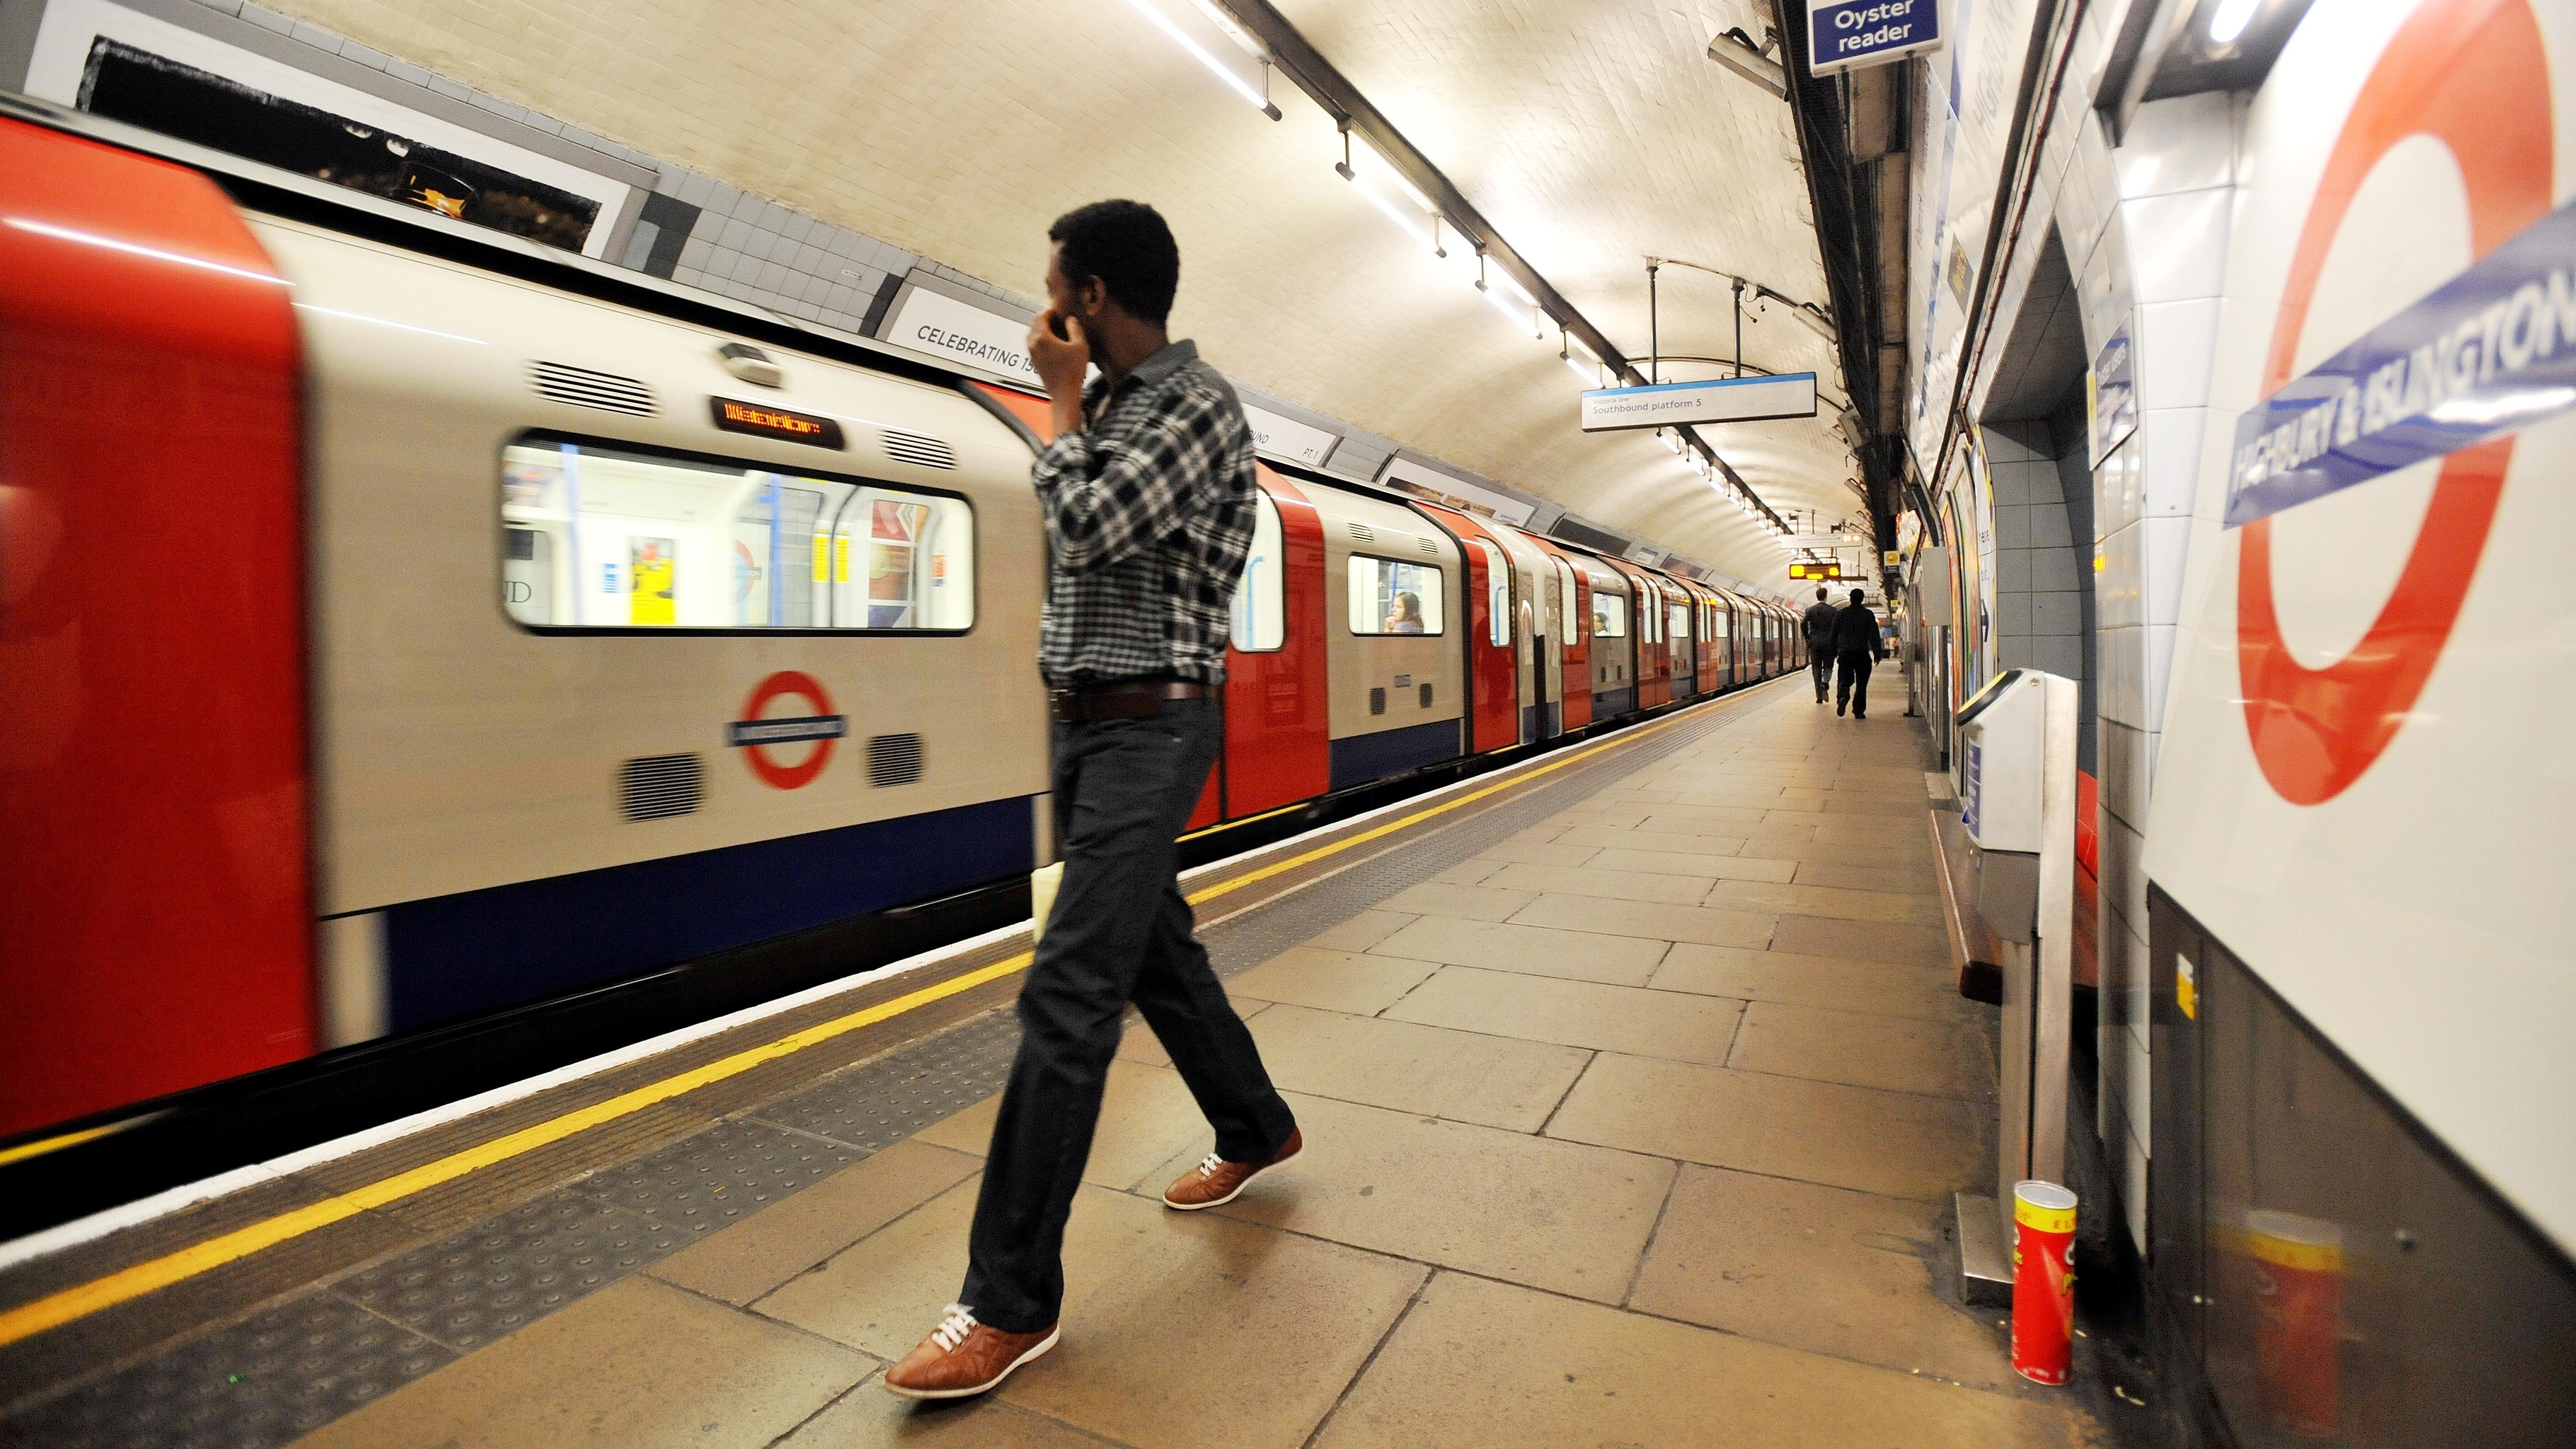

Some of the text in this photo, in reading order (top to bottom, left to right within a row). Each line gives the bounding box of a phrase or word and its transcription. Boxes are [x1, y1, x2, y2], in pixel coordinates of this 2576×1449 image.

[1835, 0, 1914, 29] Oyster
[1839, 23, 1912, 52] reader
[917, 325, 1019, 367] CELEBRATING
[2335, 378, 2360, 447] &
[2362, 271, 2576, 435] ISLINGTON
[1593, 398, 1702, 415] Southbound platform 5
